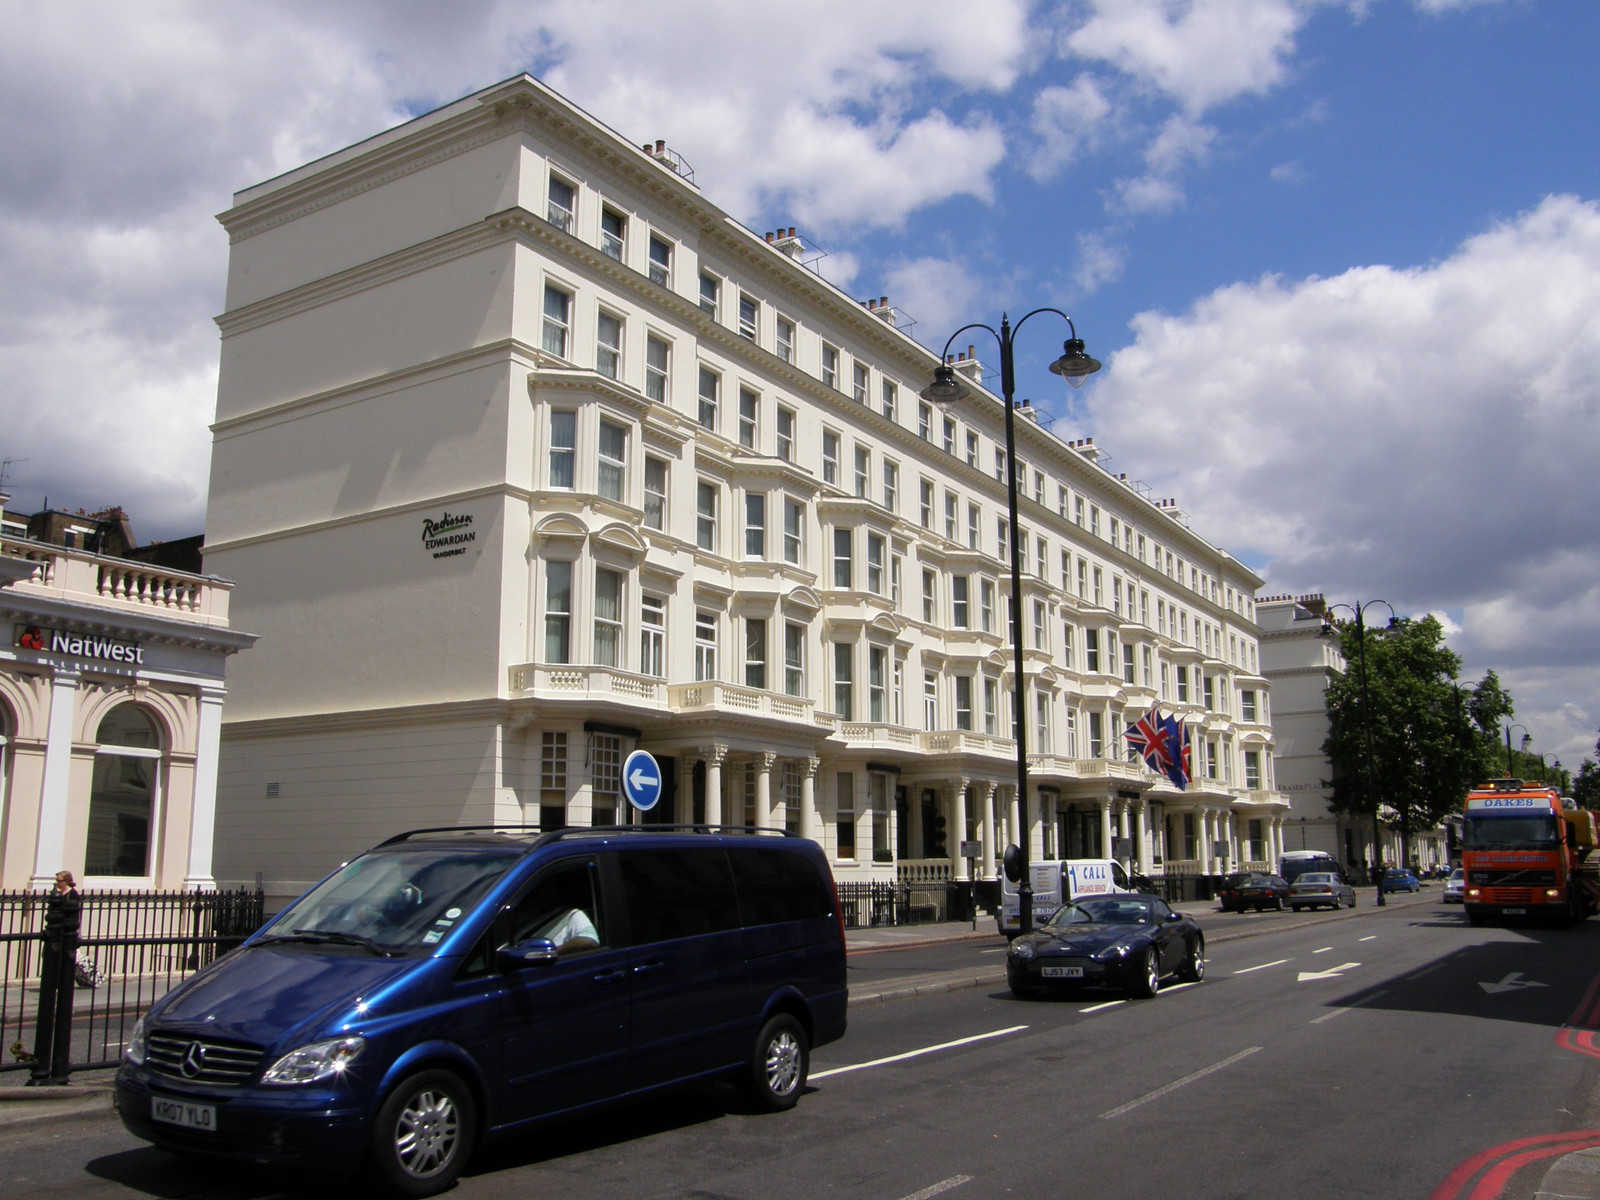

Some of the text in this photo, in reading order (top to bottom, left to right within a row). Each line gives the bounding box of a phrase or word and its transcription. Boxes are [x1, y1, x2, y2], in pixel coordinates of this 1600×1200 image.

[422, 512, 473, 541] Radisson
[425, 532, 476, 549] EDWARDIAN
[52, 630, 144, 664] NatWest
[1484, 799, 1534, 807] OAKES
[1083, 866, 1105, 879] CALL
[1043, 967, 1063, 976] LJ57
